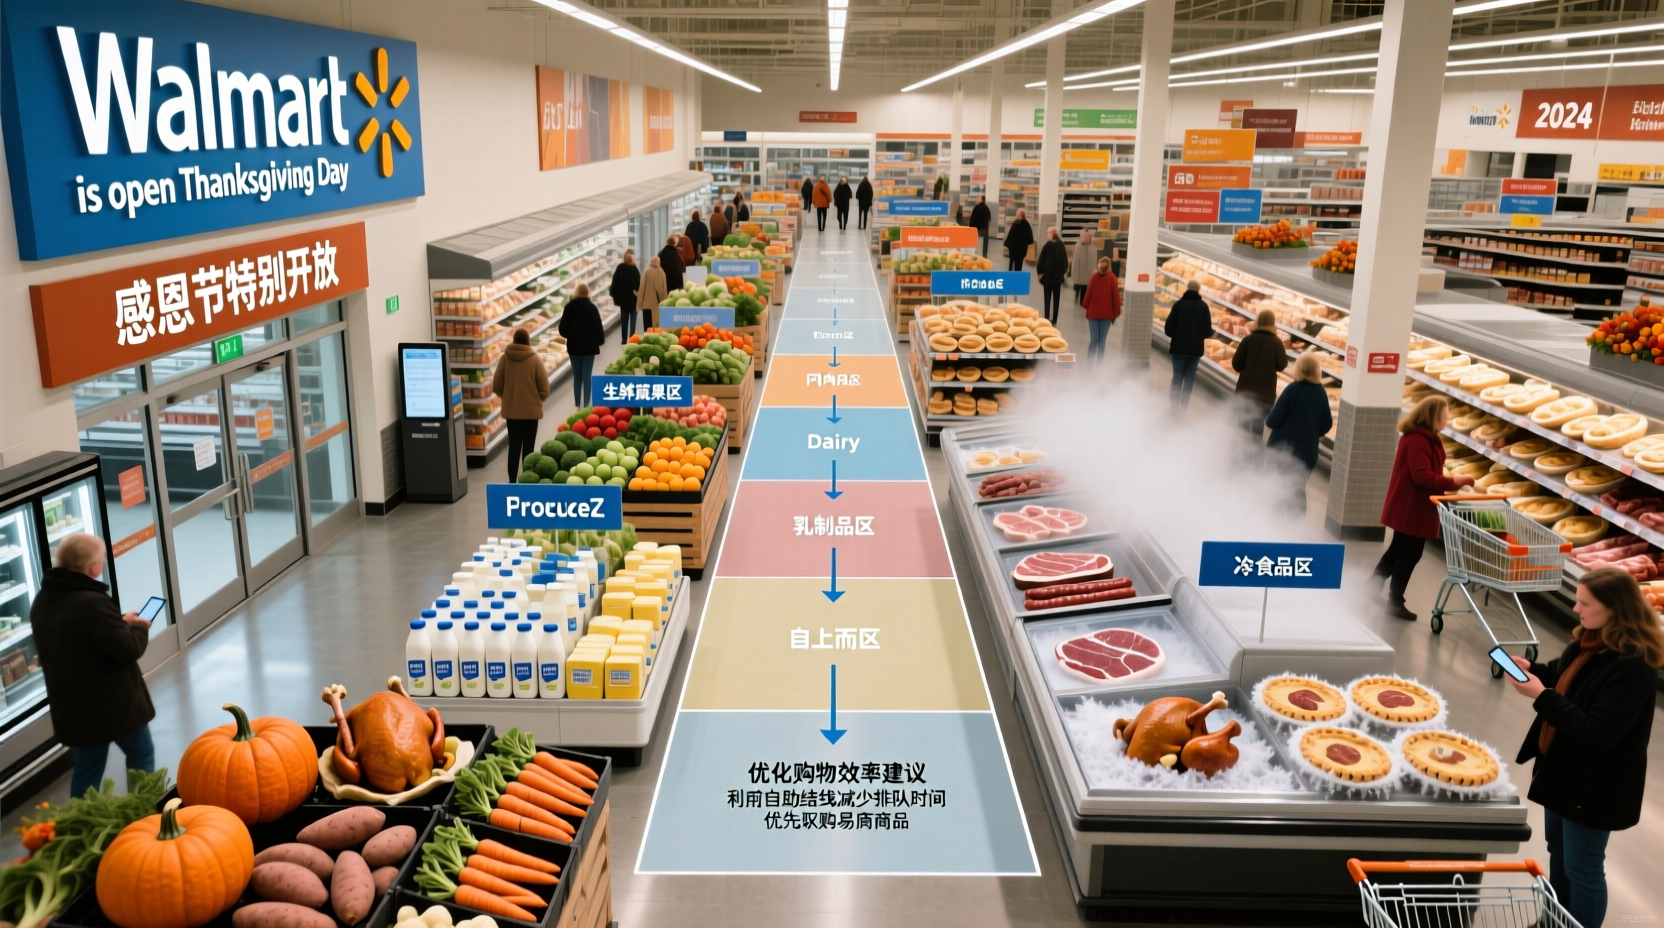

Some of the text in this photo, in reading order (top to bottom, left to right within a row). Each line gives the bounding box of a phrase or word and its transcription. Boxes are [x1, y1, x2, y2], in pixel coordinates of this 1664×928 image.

[56, 25, 350, 156] Walmart
[1534, 101, 1593, 130] 2024
[76, 157, 350, 219] is open Thanksgiving Day
[114, 239, 340, 347] 感恩节特别开放
[807, 433, 861, 454] Dairy
[793, 513, 875, 537] 乳制品区
[1233, 555, 1314, 577] 冷食品区
[790, 626, 881, 650] 自上而区
[747, 761, 927, 785] 优化购物效率建议
